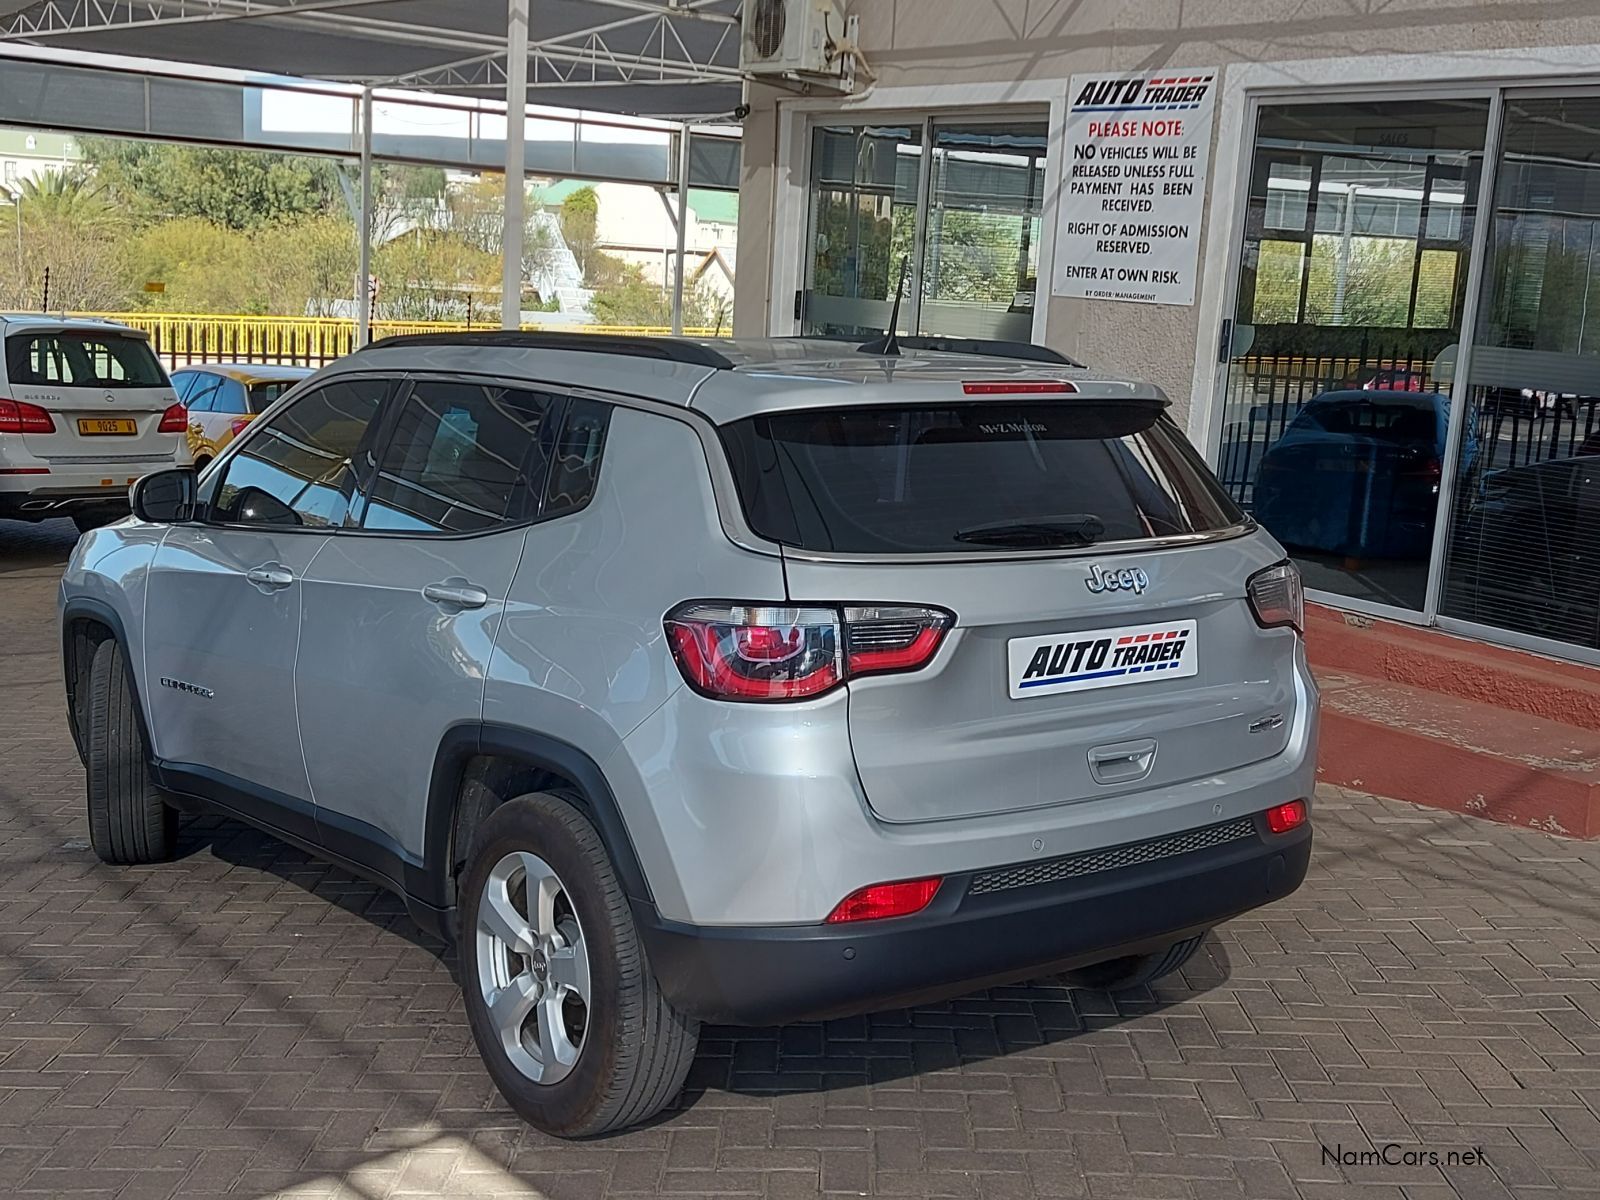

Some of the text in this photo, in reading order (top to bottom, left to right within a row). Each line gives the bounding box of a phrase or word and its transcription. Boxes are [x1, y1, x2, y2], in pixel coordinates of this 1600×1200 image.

[1074, 79, 1209, 105] AUTO TRADER
[1089, 120, 1185, 137] PLEASE NOTE:
[1073, 144, 1197, 160] NO VEHICLES WILL BE
[1072, 165, 1195, 178] RELEASED UNLESS FULL
[1070, 182, 1193, 195] PAYMENT HAS BEEN
[1102, 199, 1154, 212] RECEIVED.
[1067, 222, 1189, 238] RIGHT OF ADMISSION
[1096, 240, 1152, 254] RESERVED.
[1066, 265, 1181, 284] ENTER AT OWN RISK.
[82, 421, 88, 431] N
[1085, 564, 1149, 595] Jeep
[1022, 639, 1187, 679] AUTO TRADER
